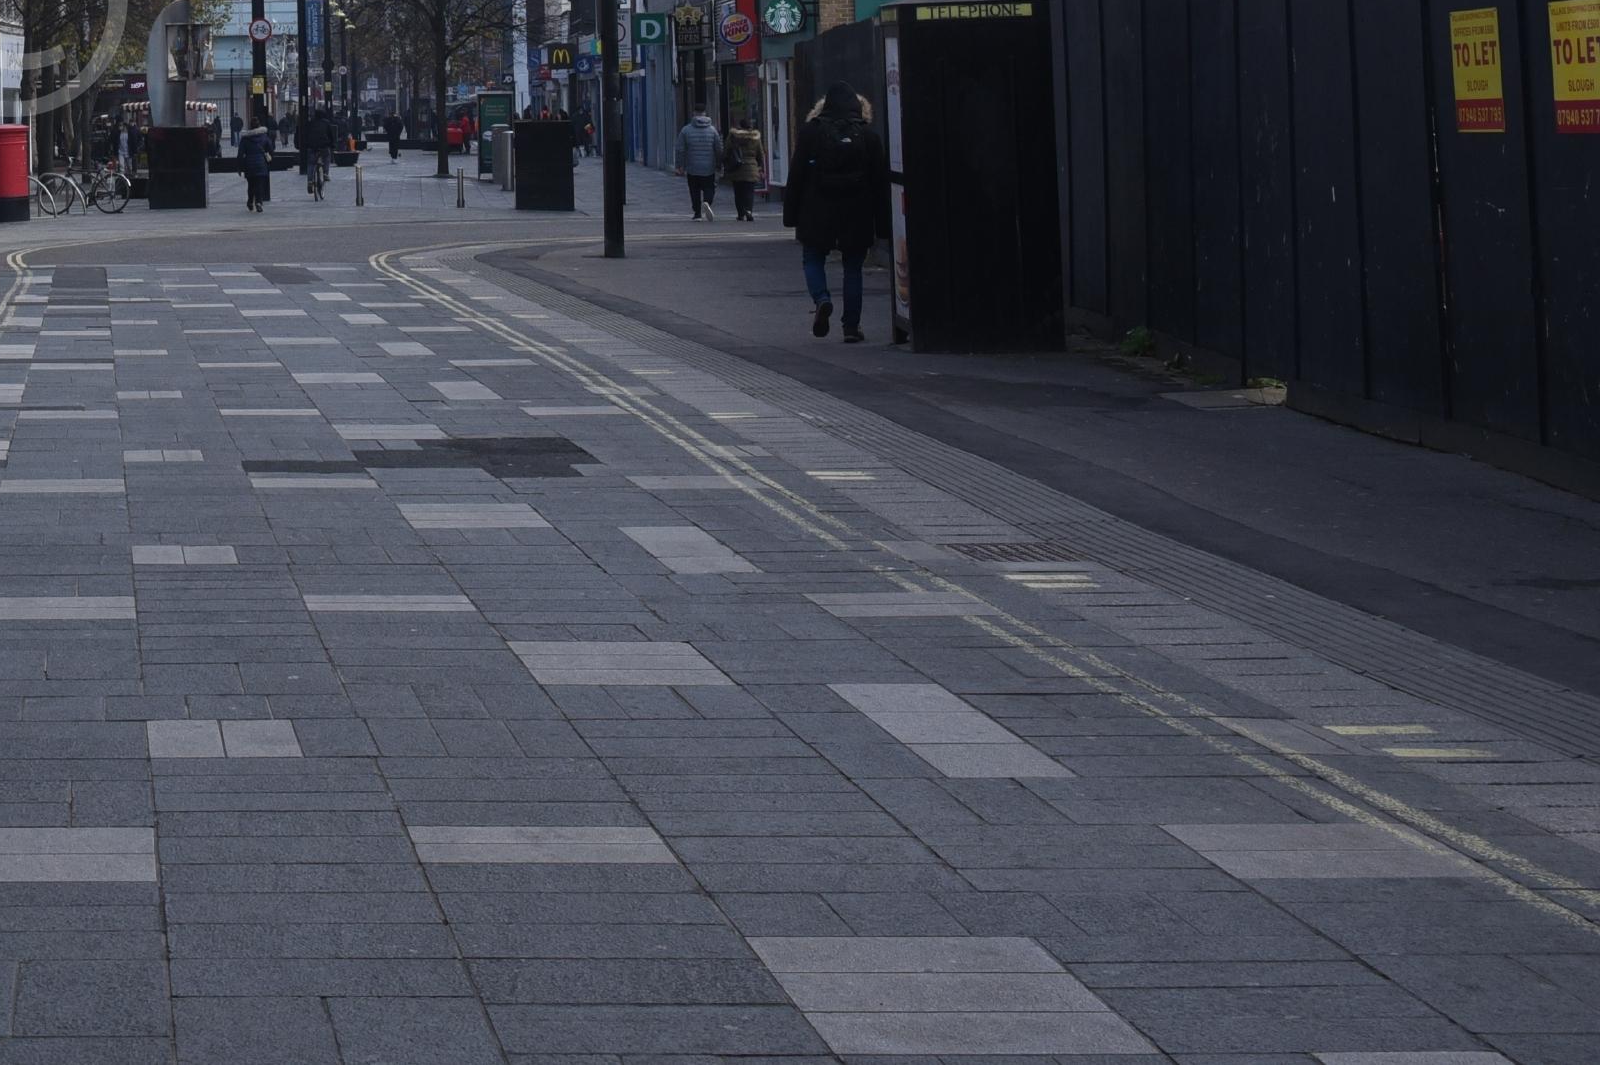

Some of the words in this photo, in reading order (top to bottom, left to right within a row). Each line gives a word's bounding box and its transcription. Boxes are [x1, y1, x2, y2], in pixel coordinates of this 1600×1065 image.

[927, 4, 1024, 19] TELEPHONE
[725, 25, 749, 38] KING
[1454, 43, 1471, 67] TO
[1473, 40, 1497, 66] LET
[1553, 38, 1573, 65] TO
[1568, 78, 1595, 92] SLOUGH
